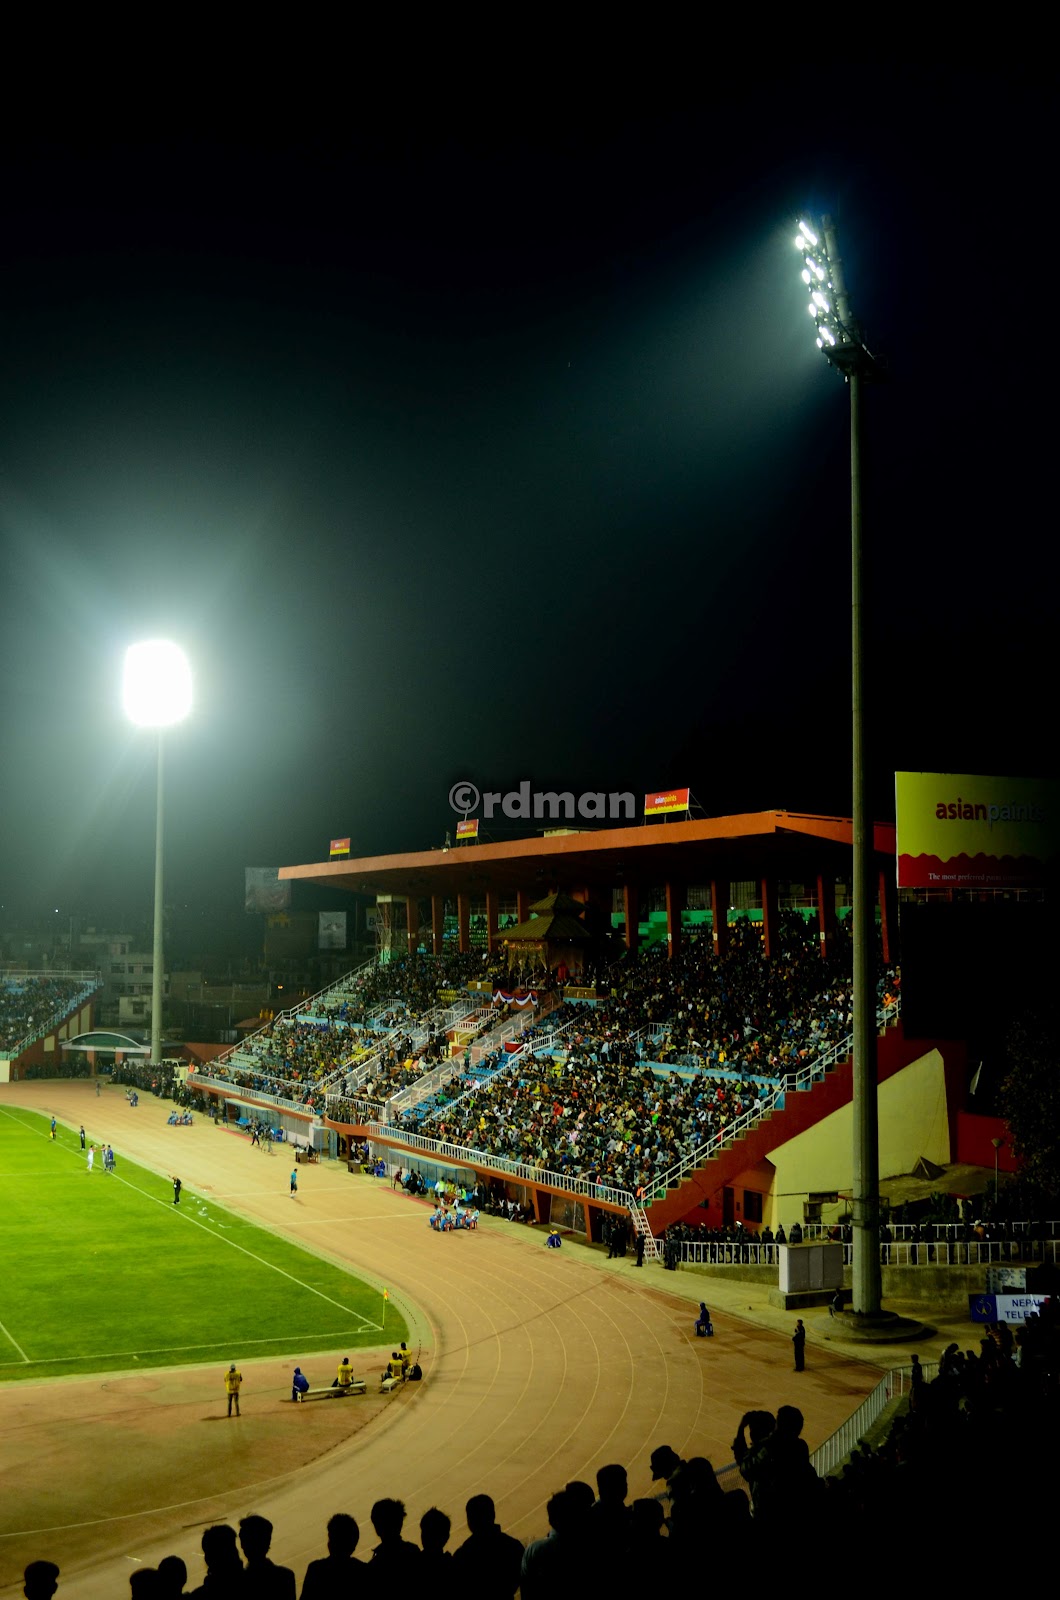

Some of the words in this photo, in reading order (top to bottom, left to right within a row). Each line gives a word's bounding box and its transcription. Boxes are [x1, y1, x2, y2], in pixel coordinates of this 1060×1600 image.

[928, 872, 941, 881] The
[942, 873, 957, 881] most
[957, 873, 985, 883] preferred
